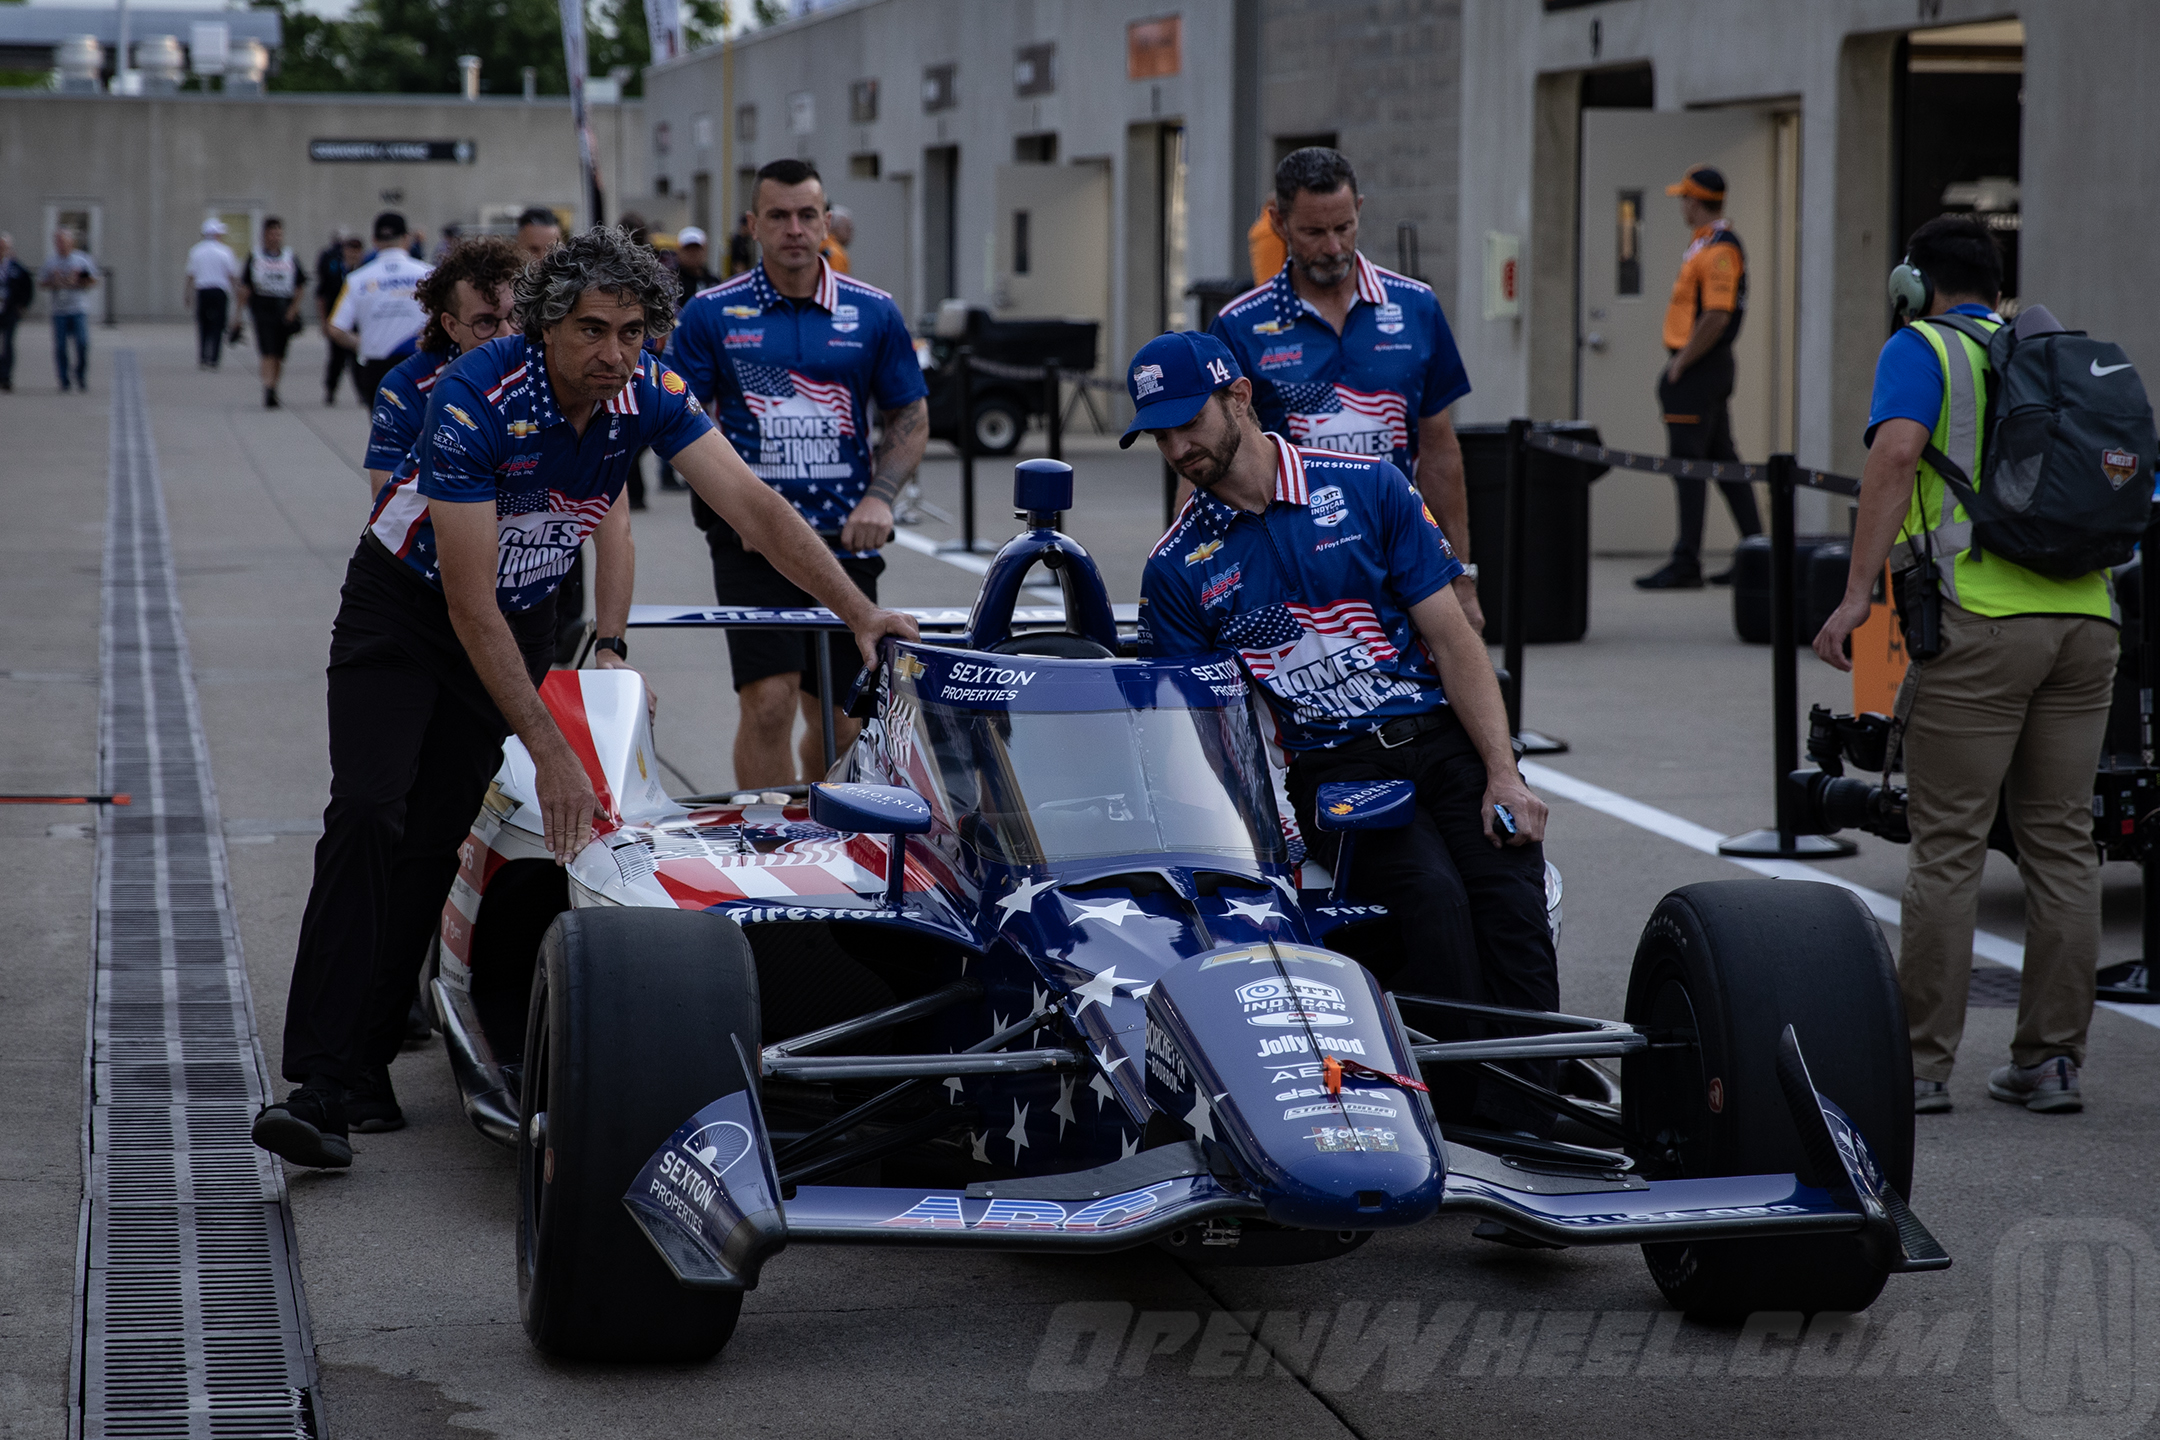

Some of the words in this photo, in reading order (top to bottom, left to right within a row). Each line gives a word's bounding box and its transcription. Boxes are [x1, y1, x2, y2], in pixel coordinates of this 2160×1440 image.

[1205, 357, 1232, 385] 14
[760, 417, 841, 438] HOMES
[432, 433, 467, 453] SEXTON
[783, 438, 841, 464] TROOPS
[1302, 460, 1372, 471] Firestone
[1310, 499, 1345, 515] INDYCAR
[1323, 490, 1339, 501] NTT
[1315, 543, 1324, 552] AJ
[1324, 540, 1340, 550] Foyt
[1340, 533, 1362, 544] Racing
[1200, 562, 1241, 605] ABC
[1204, 594, 1224, 611] Supply
[1233, 582, 1244, 592] Inc.
[948, 661, 1037, 686] SEXTON
[1190, 655, 1242, 682] SEXTON
[1268, 644, 1377, 698] HOMES
[940, 685, 1019, 701] PROPERTIES
[847, 785, 927, 814] PHOENIX
[1343, 779, 1405, 804] PHOENIX
[724, 906, 923, 927] Firestone
[1284, 984, 1333, 997] NTT
[1243, 998, 1347, 1013] INDYCAR
[1266, 1003, 1327, 1014] SERIES
[1151, 1056, 1178, 1094] BOURBON
[659, 1150, 717, 1212] SEXTON
[648, 1178, 704, 1236] PROPERTIES
[873, 1180, 1173, 1230] ABC
